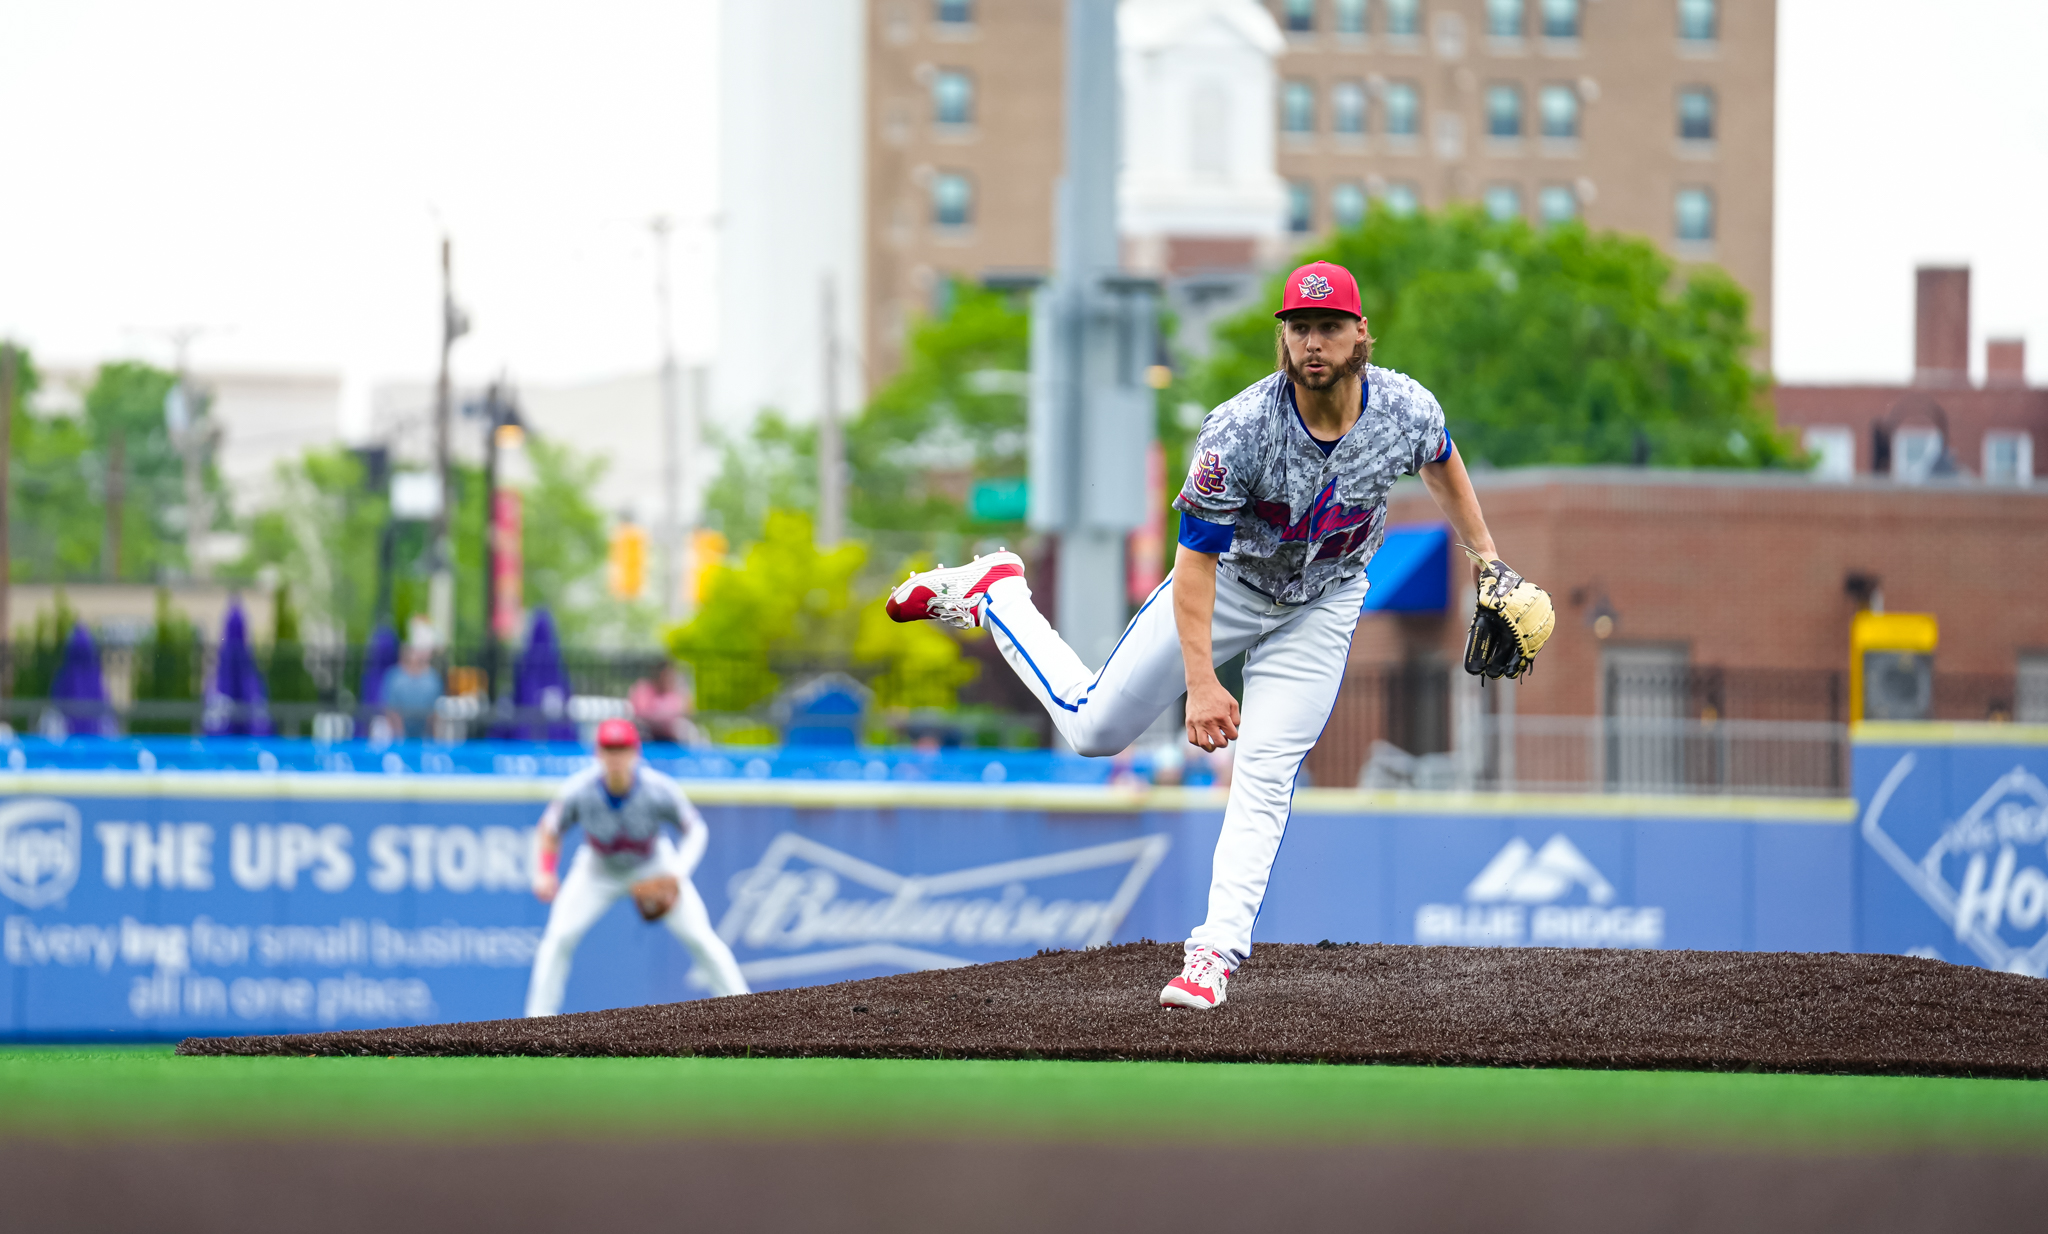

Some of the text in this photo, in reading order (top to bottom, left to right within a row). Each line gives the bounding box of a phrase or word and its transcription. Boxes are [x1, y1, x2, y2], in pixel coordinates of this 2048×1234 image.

[97, 822, 215, 889] THE
[230, 823, 354, 892] UPS
[728, 868, 1109, 948] Budweiser
[1414, 903, 1665, 946] BLUE RIDGE
[4, 916, 118, 972] Every
[191, 915, 250, 966] for
[255, 918, 367, 967] small
[130, 974, 180, 1017] all
[184, 973, 228, 1016] in
[230, 978, 315, 1019] one
